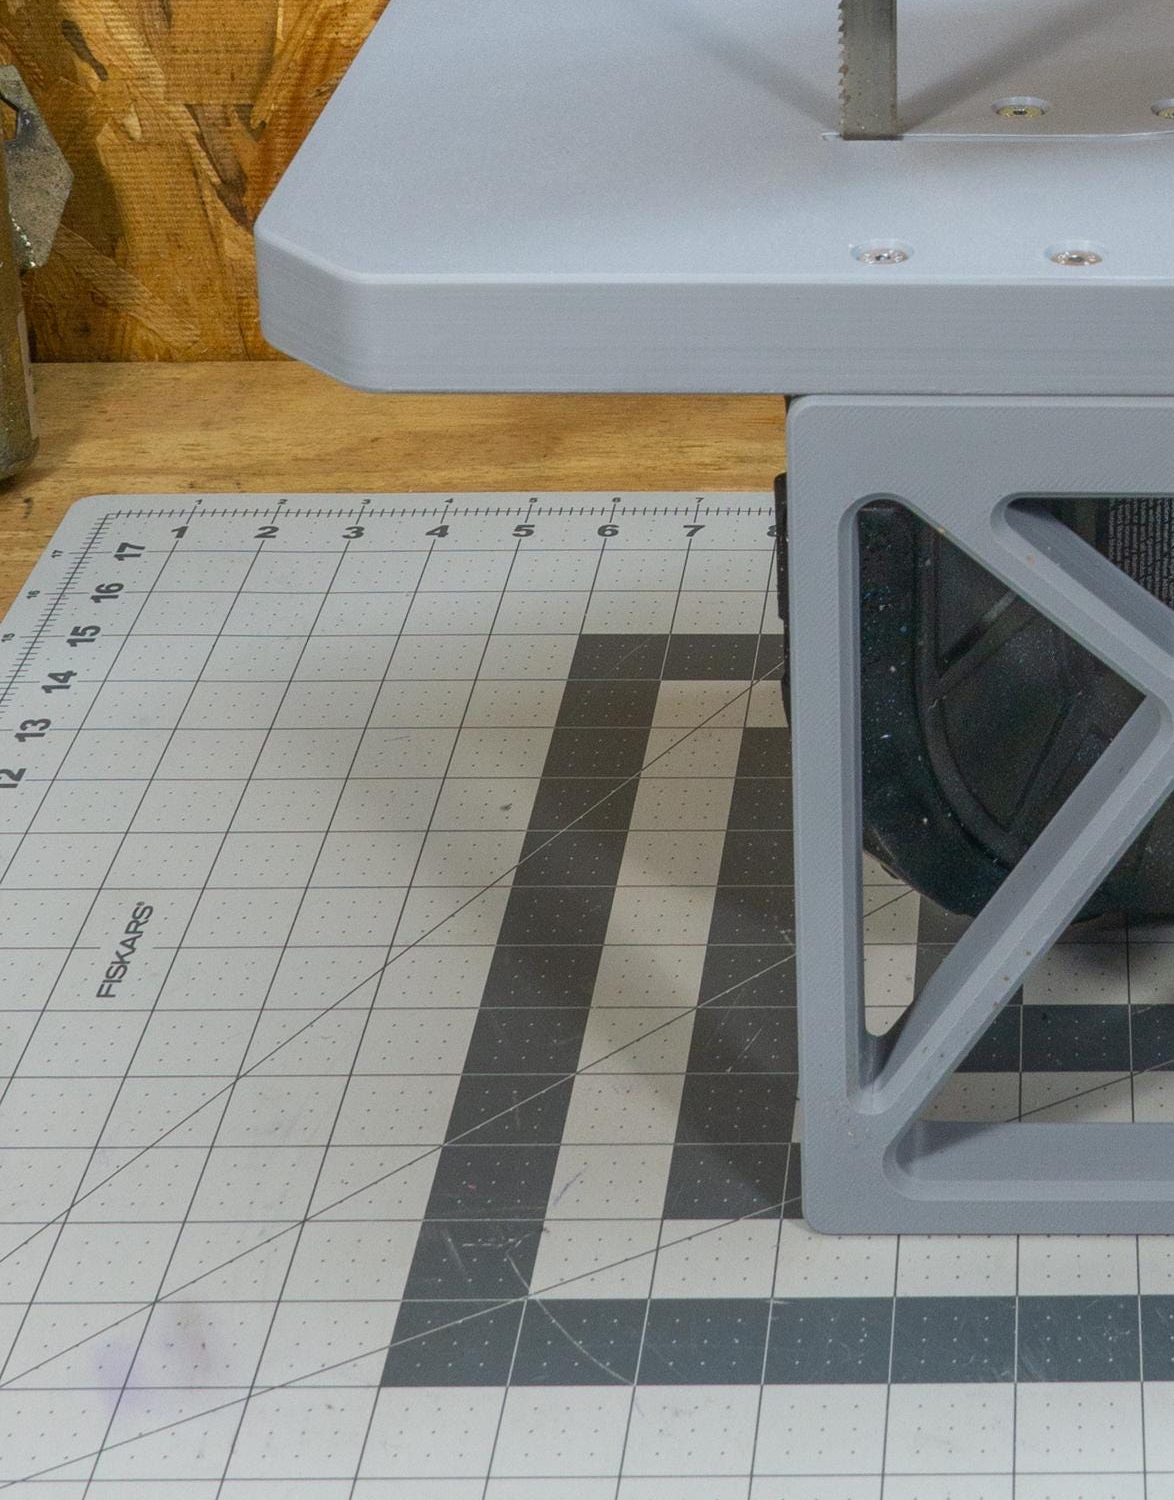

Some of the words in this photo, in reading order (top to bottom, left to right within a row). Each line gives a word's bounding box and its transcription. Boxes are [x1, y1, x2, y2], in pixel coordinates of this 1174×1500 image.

[170, 526, 189, 539] 1
[253, 526, 279, 539] 2
[342, 526, 365, 539] 3
[425, 525, 450, 538] 4
[512, 525, 535, 537] 5
[597, 525, 620, 537] 6
[682, 525, 705, 537] 7
[51, 549, 64, 559] 17
[113, 542, 146, 561] 17
[91, 582, 124, 603] 16
[66, 624, 101, 647] 15
[41, 670, 77, 694] 14
[14, 718, 51, 742] 13
[0, 767, 26, 788] 12
